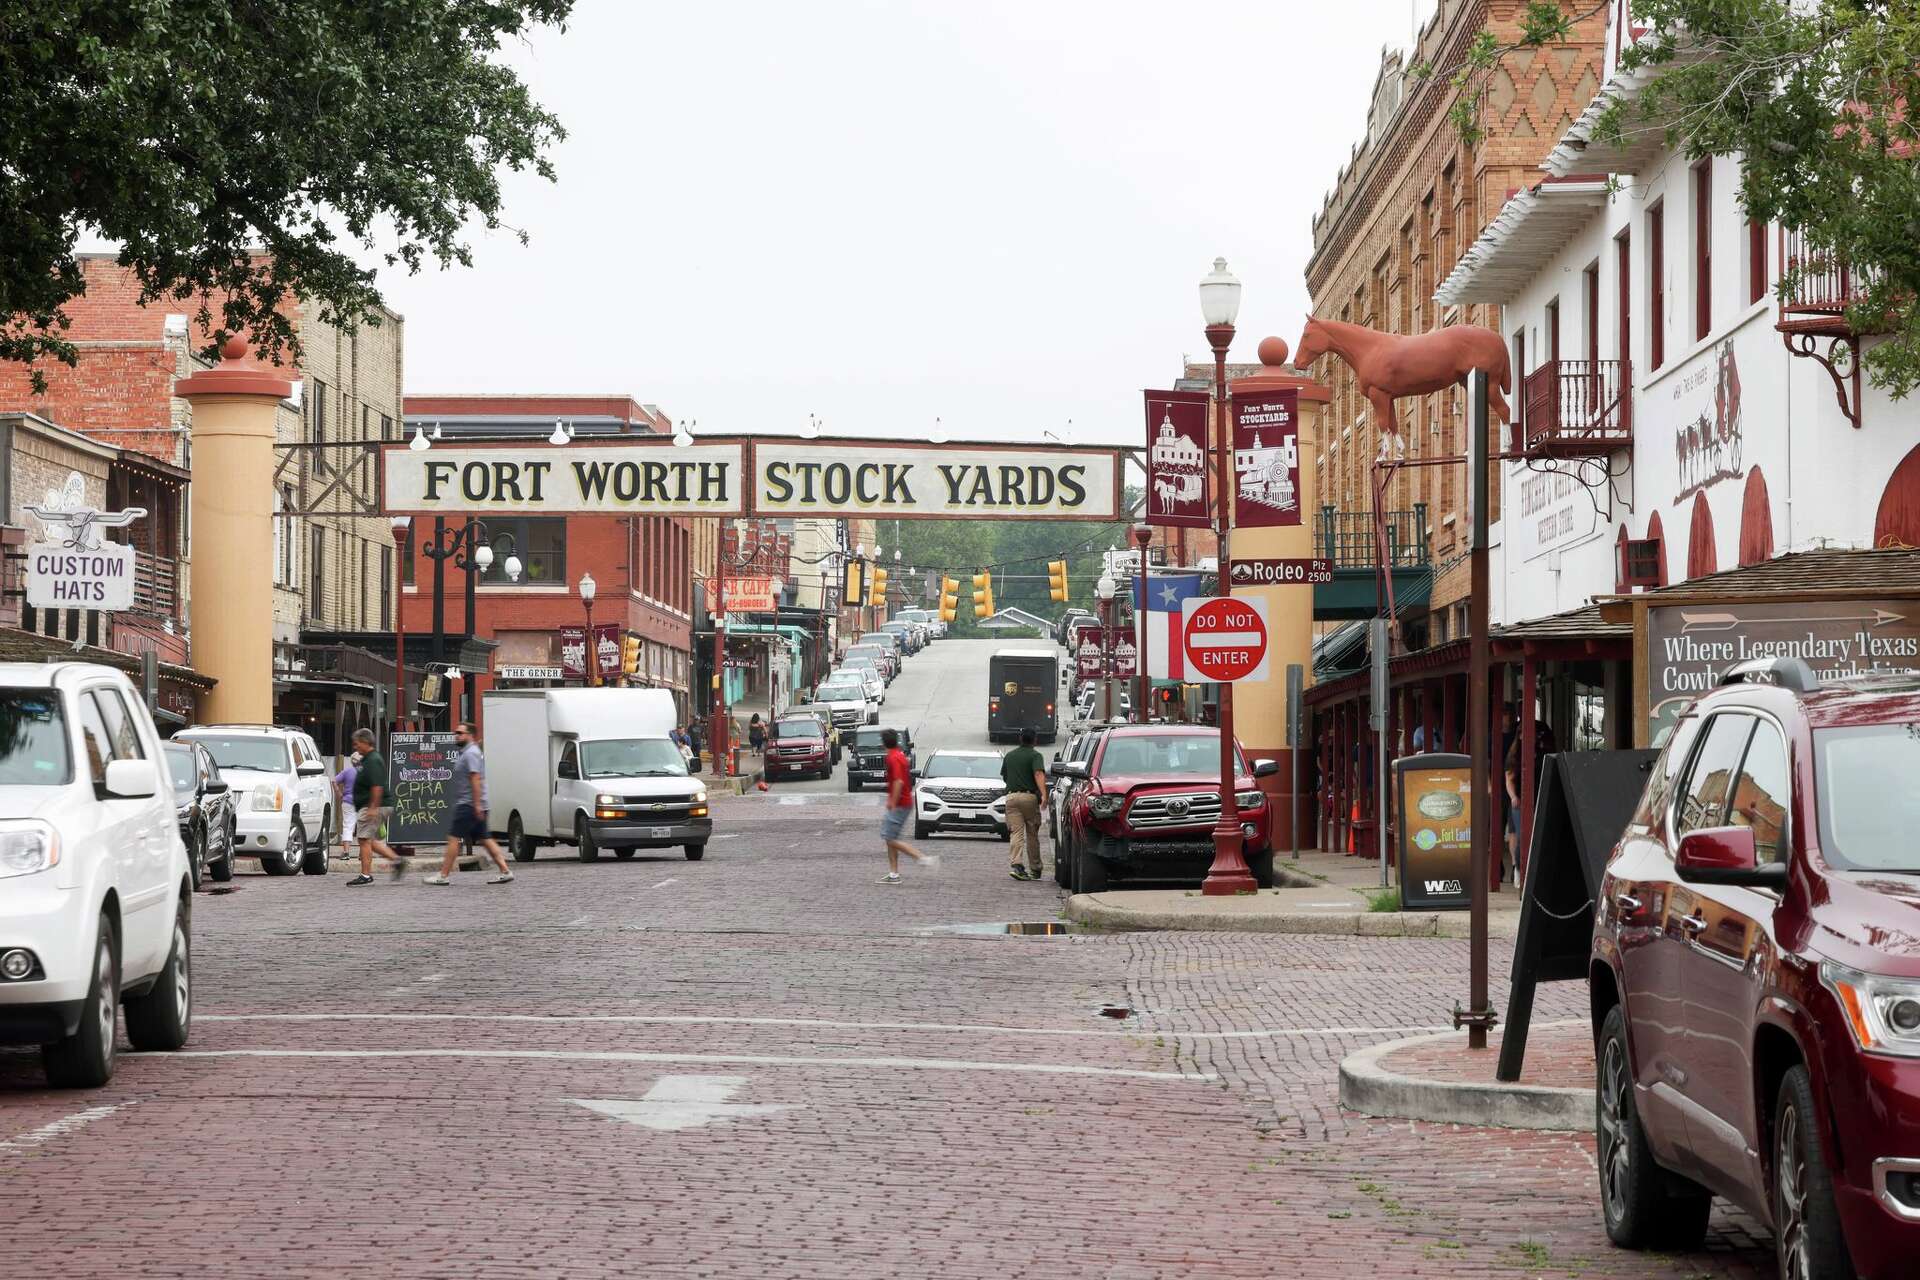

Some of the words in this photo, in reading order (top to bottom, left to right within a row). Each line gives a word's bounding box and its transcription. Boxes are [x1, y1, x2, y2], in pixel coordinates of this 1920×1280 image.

[1240, 412, 1289, 424] STOCKYARDS
[422, 460, 551, 503] FORT
[571, 460, 730, 503] WORTH
[766, 461, 917, 505] STOCK
[938, 464, 1086, 507] YARDS
[37, 554, 123, 577] CUSTOM
[1254, 561, 1304, 581] Rodeo
[1313, 560, 1326, 571] Plz
[1308, 572, 1331, 582] 2500
[54, 580, 105, 601] HATS
[1197, 615, 1216, 628] DO
[1226, 614, 1254, 627] NOT
[1663, 635, 1734, 662] Where
[1738, 632, 1851, 662] Legendary
[1855, 632, 1917, 657] Texas
[1203, 652, 1249, 665] ENTER
[506, 669, 525, 677] THE
[528, 669, 562, 677] GENER
[1663, 665, 1754, 691] Cowbs
[395, 781, 443, 797] CPRA
[396, 799, 413, 811] AT
[397, 811, 440, 826] PARK
[1441, 828, 1454, 842] Fort
